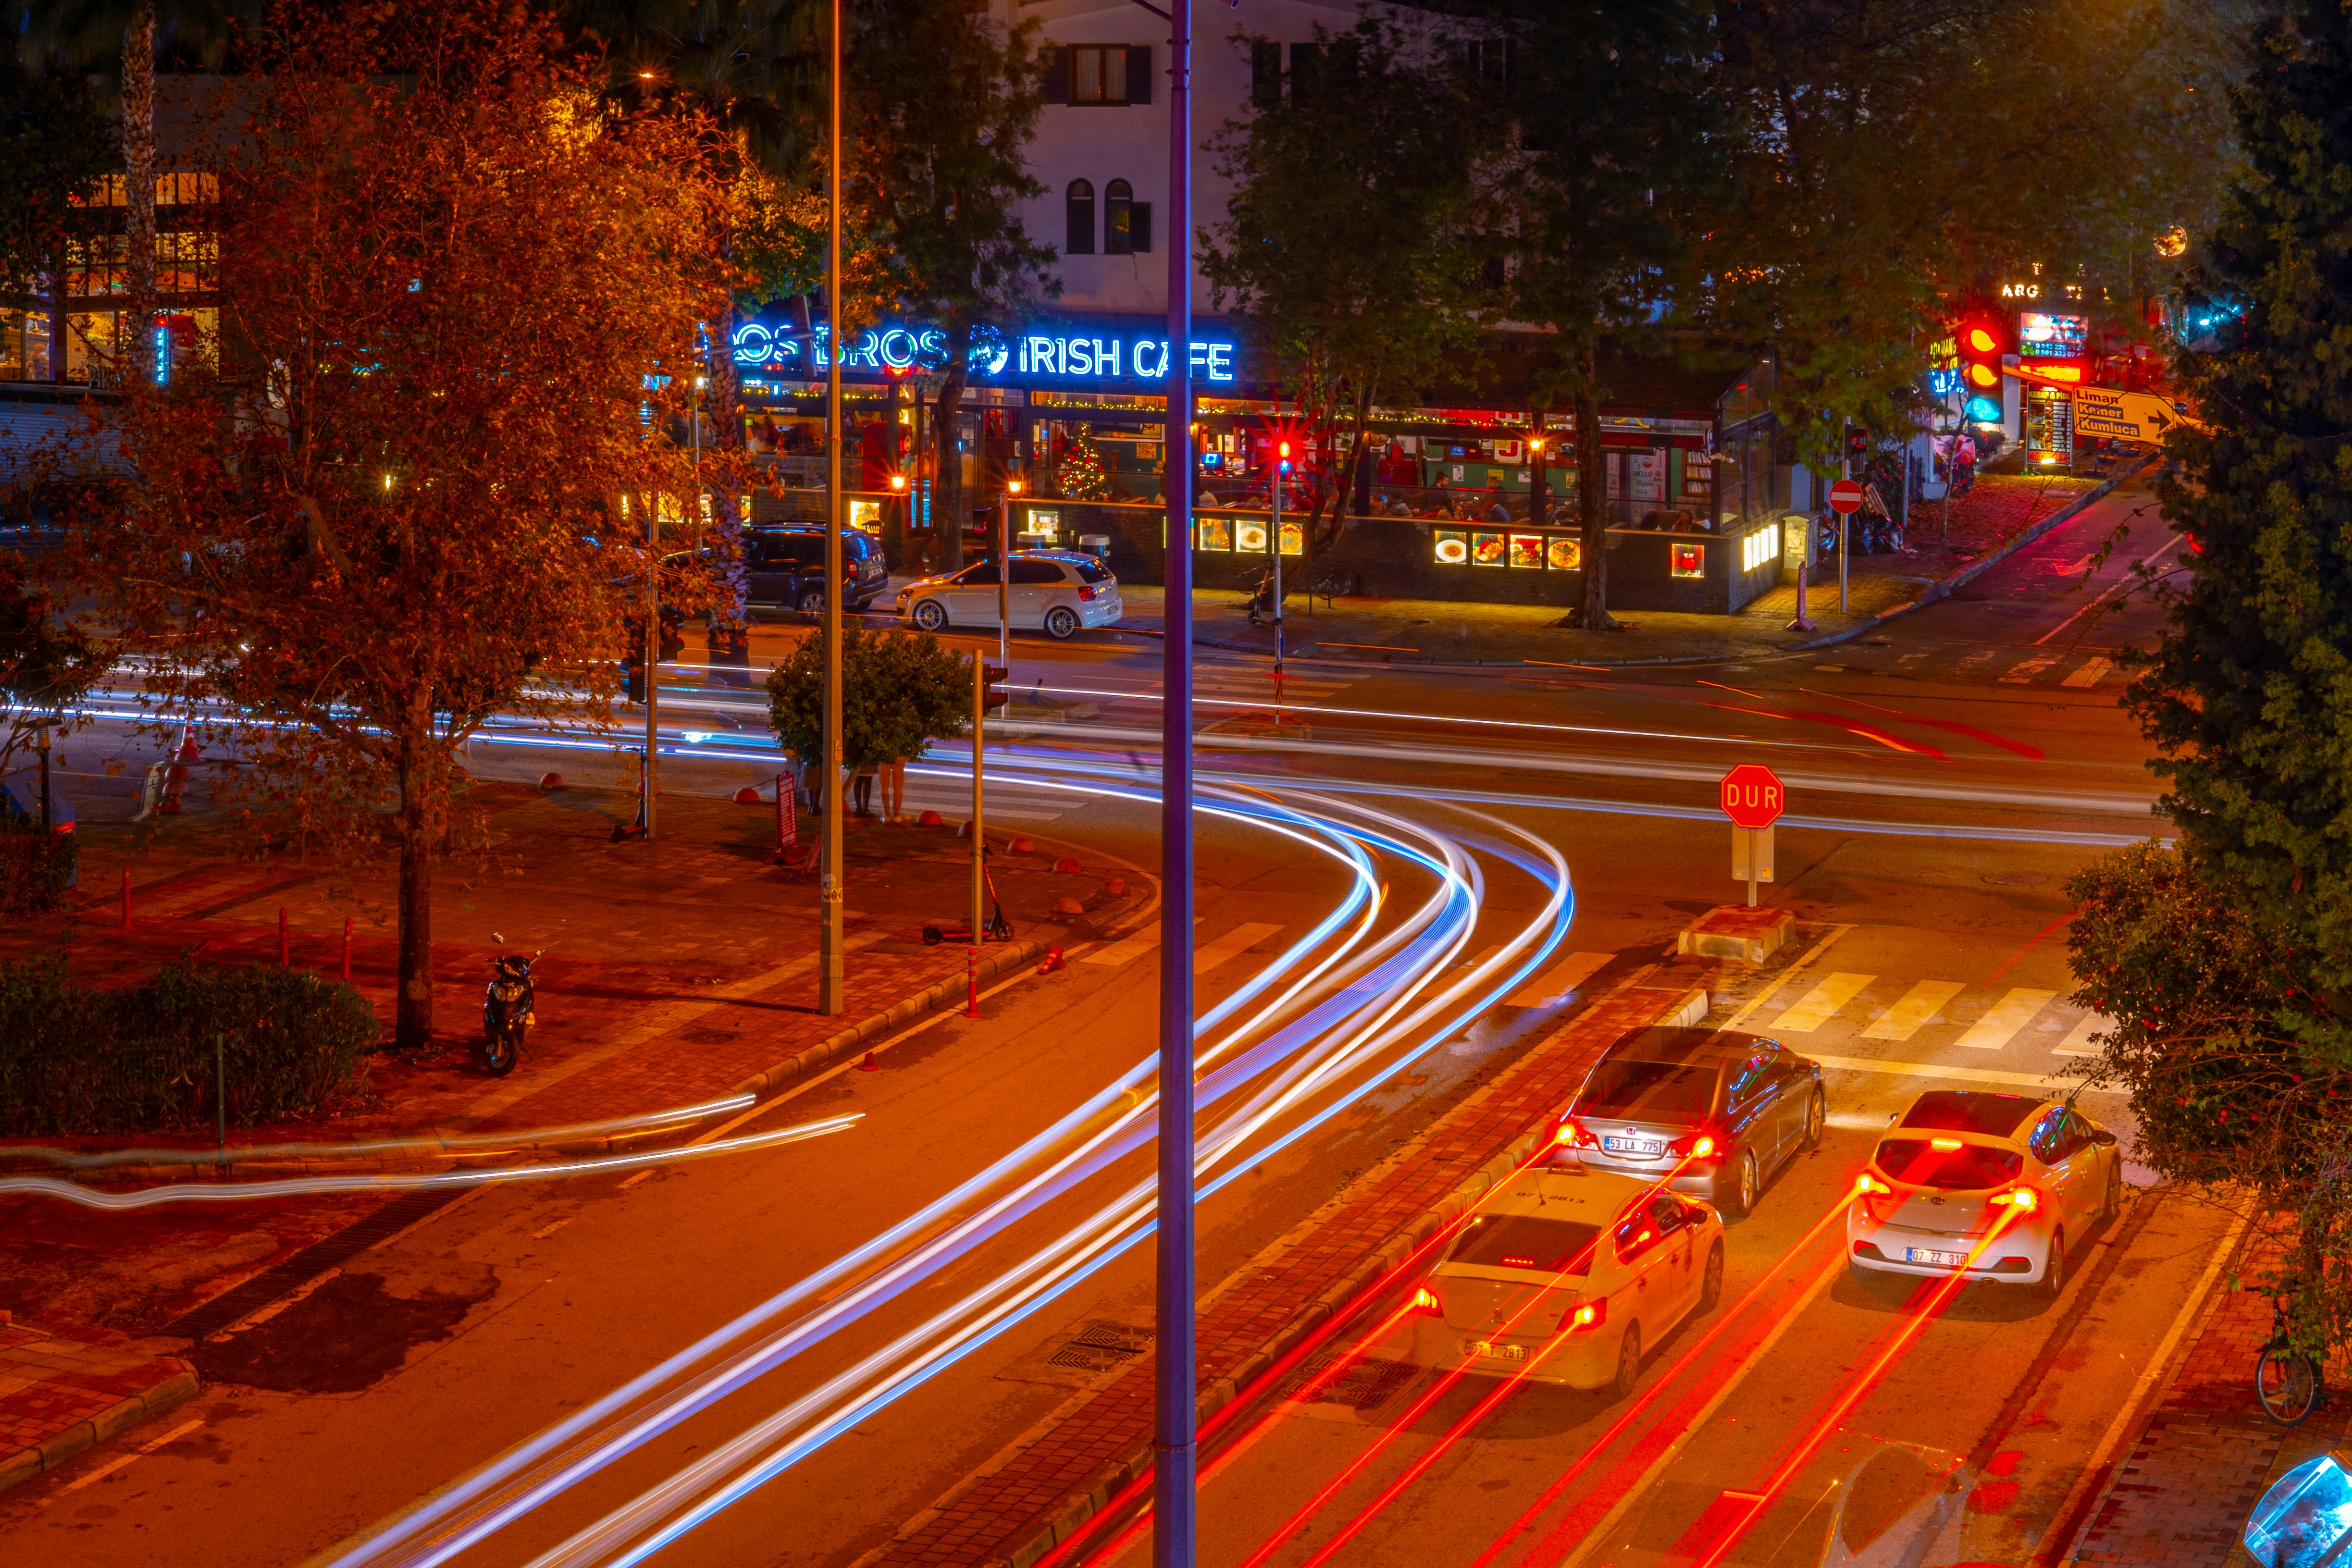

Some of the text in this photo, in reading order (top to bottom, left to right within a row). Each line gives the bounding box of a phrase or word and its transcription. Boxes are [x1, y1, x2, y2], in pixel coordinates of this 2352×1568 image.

[813, 327, 947, 369] BROS
[1018, 336, 1121, 376] IRISH
[2076, 390, 2118, 404] Liman
[2079, 403, 2121, 417] Kemer
[2080, 418, 2138, 436] Kumluca
[1727, 784, 1777, 809] DUR
[1610, 1139, 1620, 1148] 53
[1625, 1140, 1635, 1150] LA
[1643, 1142, 1658, 1152] 775
[1549, 1196, 1585, 1204] 2813
[1913, 1250, 1966, 1265] 07 ZZ 310
[1490, 1346, 1495, 1356] T
[1503, 1347, 1527, 1360] 2813
